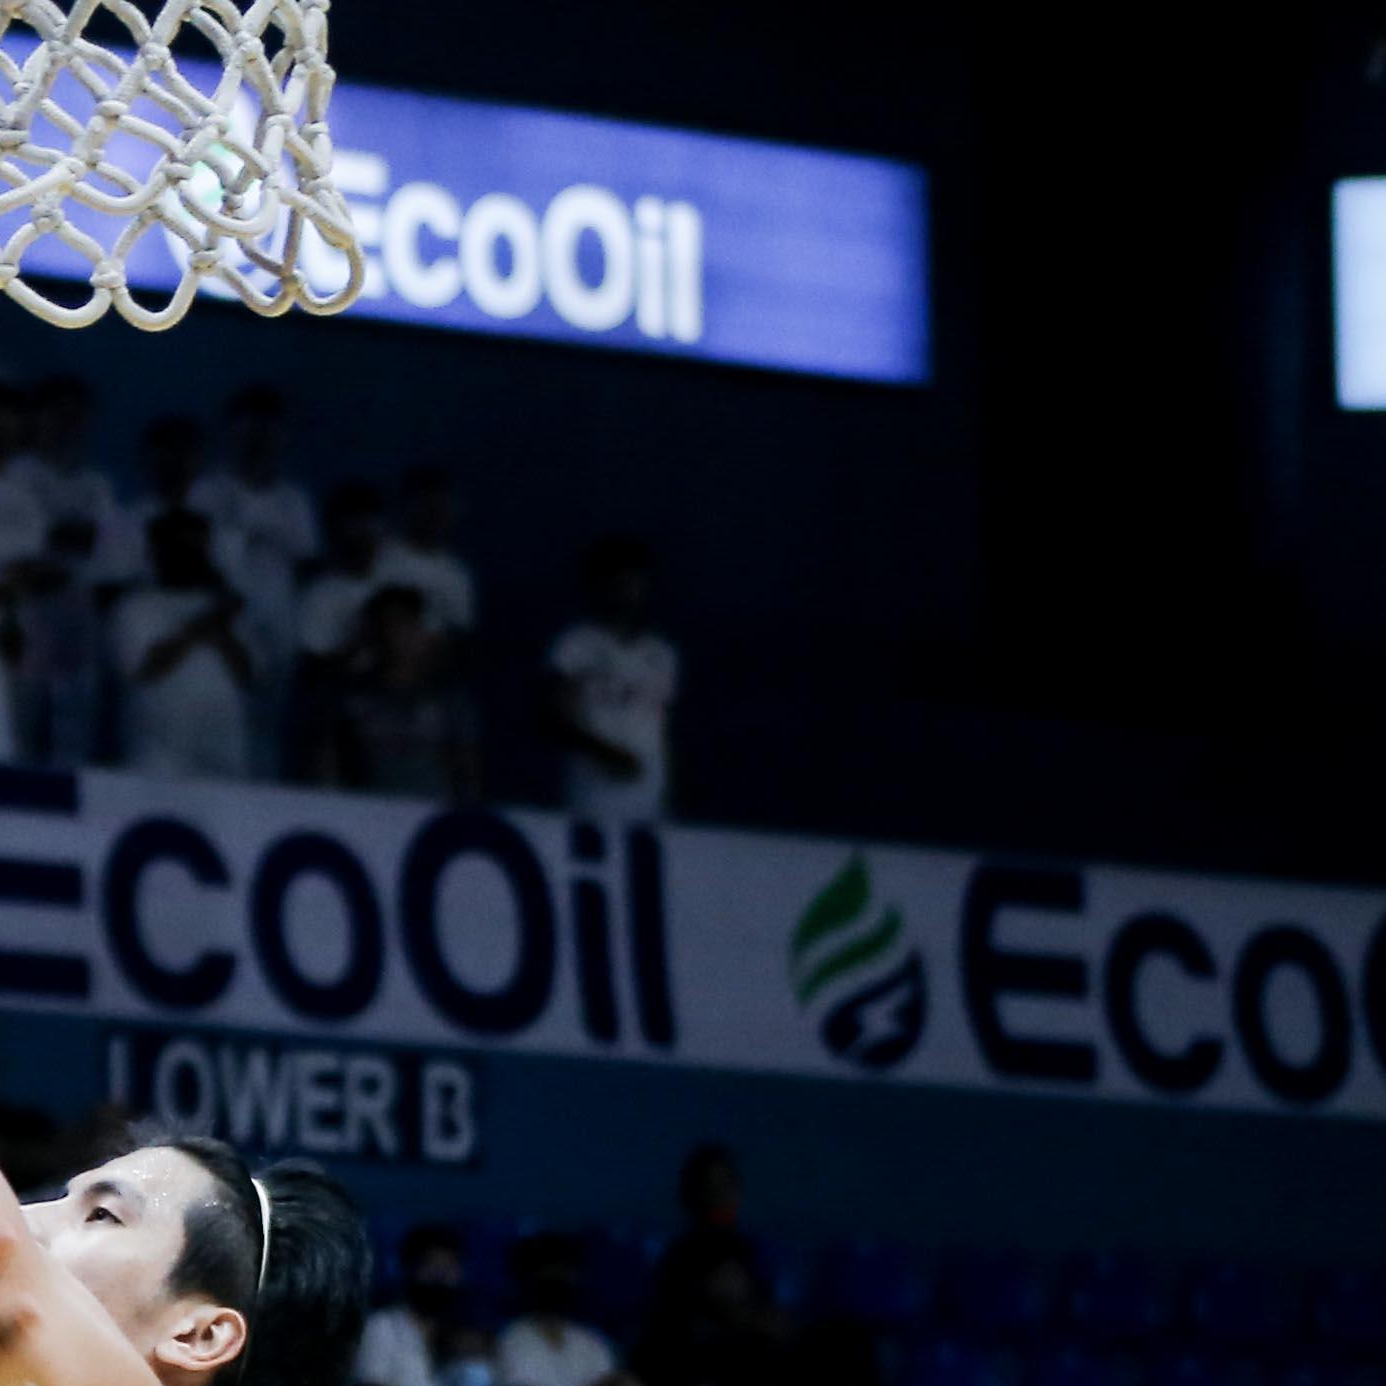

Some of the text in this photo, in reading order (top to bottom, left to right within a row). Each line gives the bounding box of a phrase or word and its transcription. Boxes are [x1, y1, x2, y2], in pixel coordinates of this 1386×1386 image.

[302, 148, 704, 345] EcoOil
[957, 855, 1386, 1107] Eco
[422, 1061, 474, 1162] B
